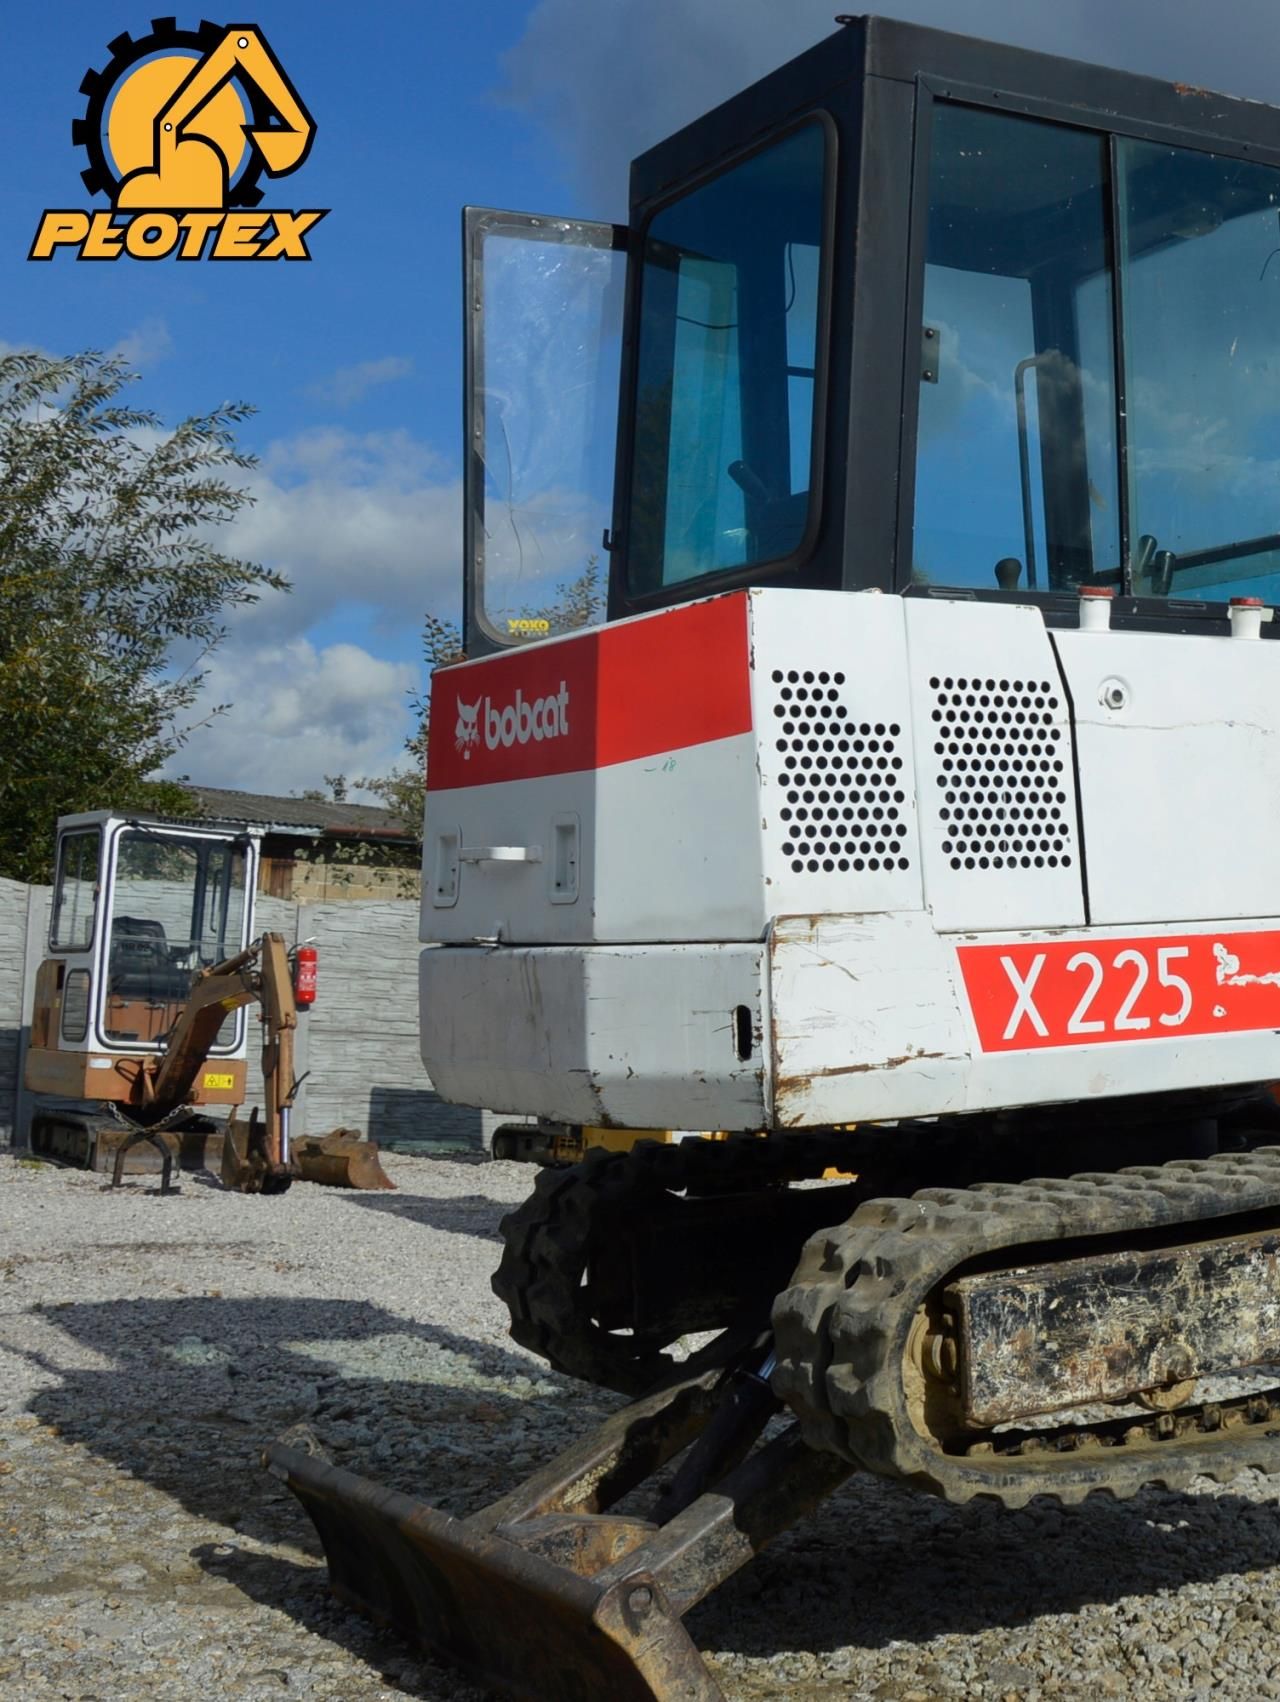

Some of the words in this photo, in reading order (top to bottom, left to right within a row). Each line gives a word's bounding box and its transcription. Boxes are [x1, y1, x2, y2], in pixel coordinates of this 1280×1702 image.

[485, 680, 569, 750] bobcat
[1000, 954, 1049, 1040] X
[1066, 946, 1193, 1034] 225
